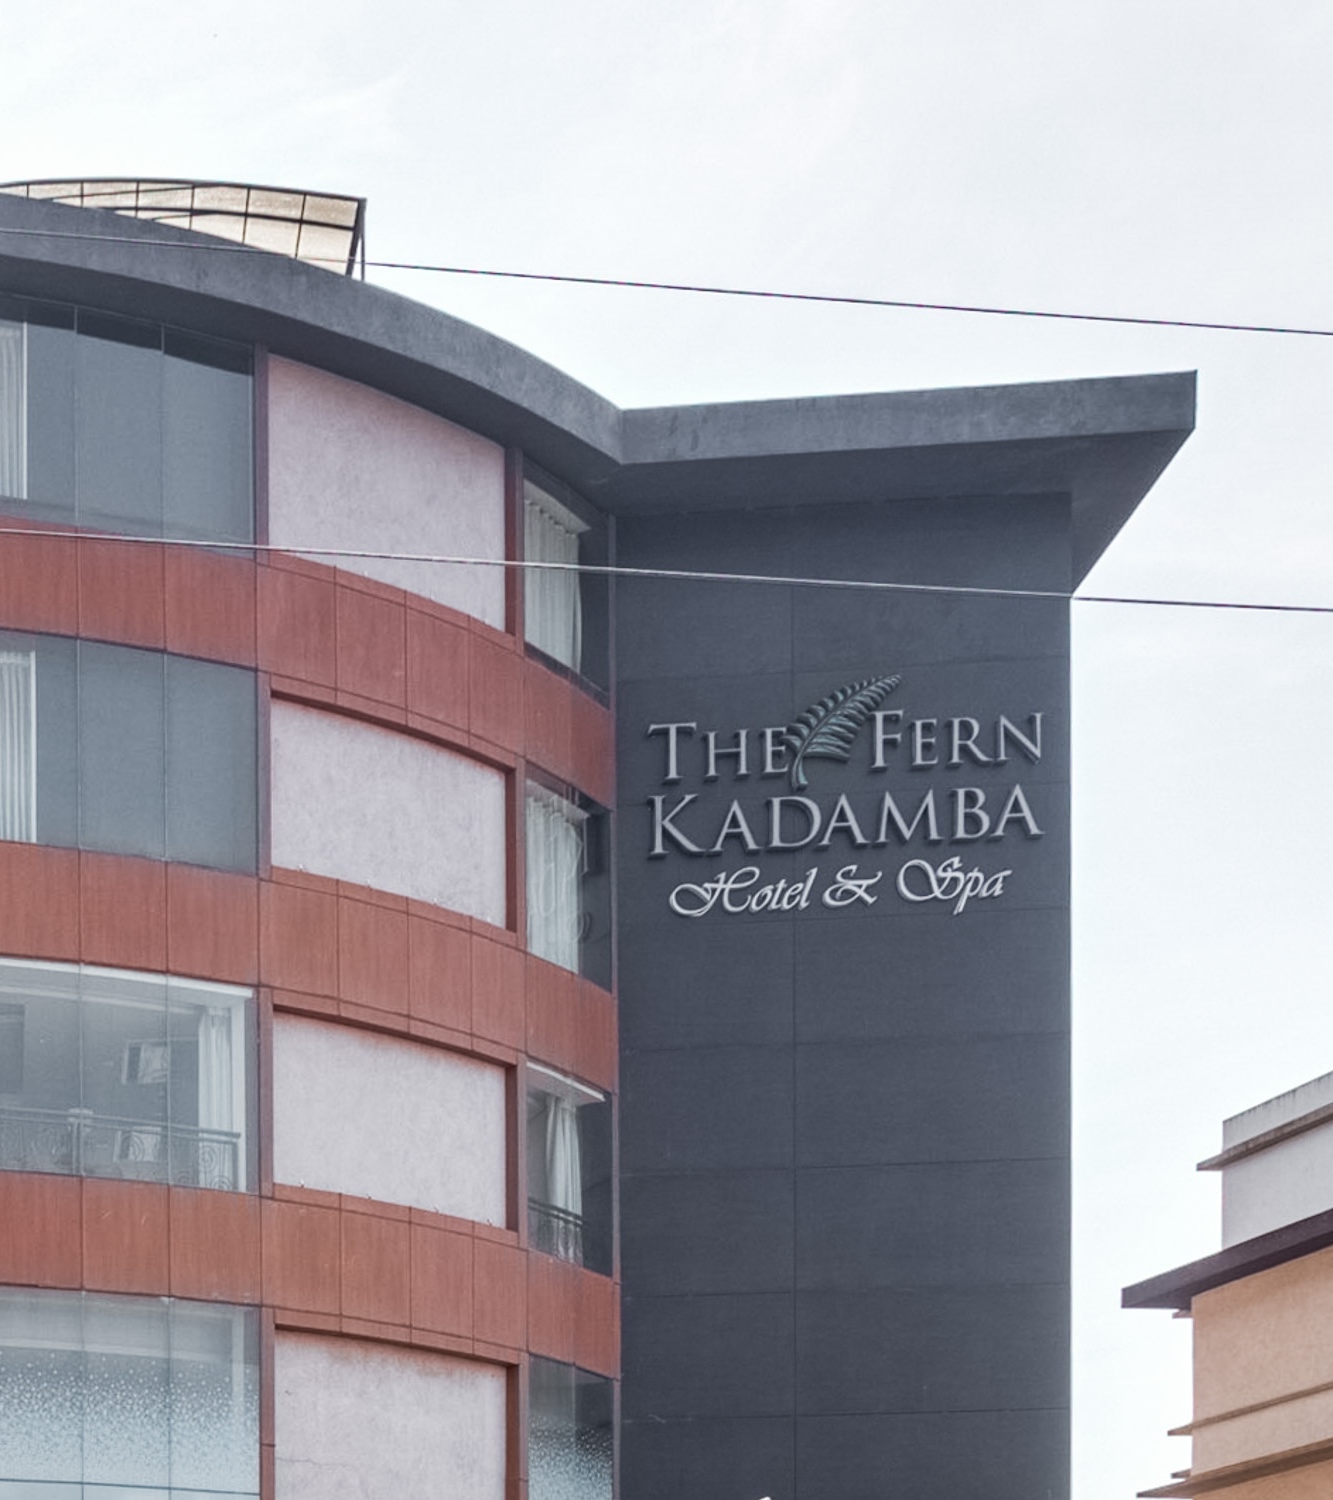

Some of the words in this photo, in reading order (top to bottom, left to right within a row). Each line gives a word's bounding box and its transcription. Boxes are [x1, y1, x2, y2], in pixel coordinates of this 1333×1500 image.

[647, 721, 791, 785] THE
[870, 709, 1044, 773] FERN
[647, 784, 1045, 858] KADAMBA
[669, 866, 818, 917] Hotel
[823, 865, 882, 907] &
[896, 856, 1012, 915] Spa
